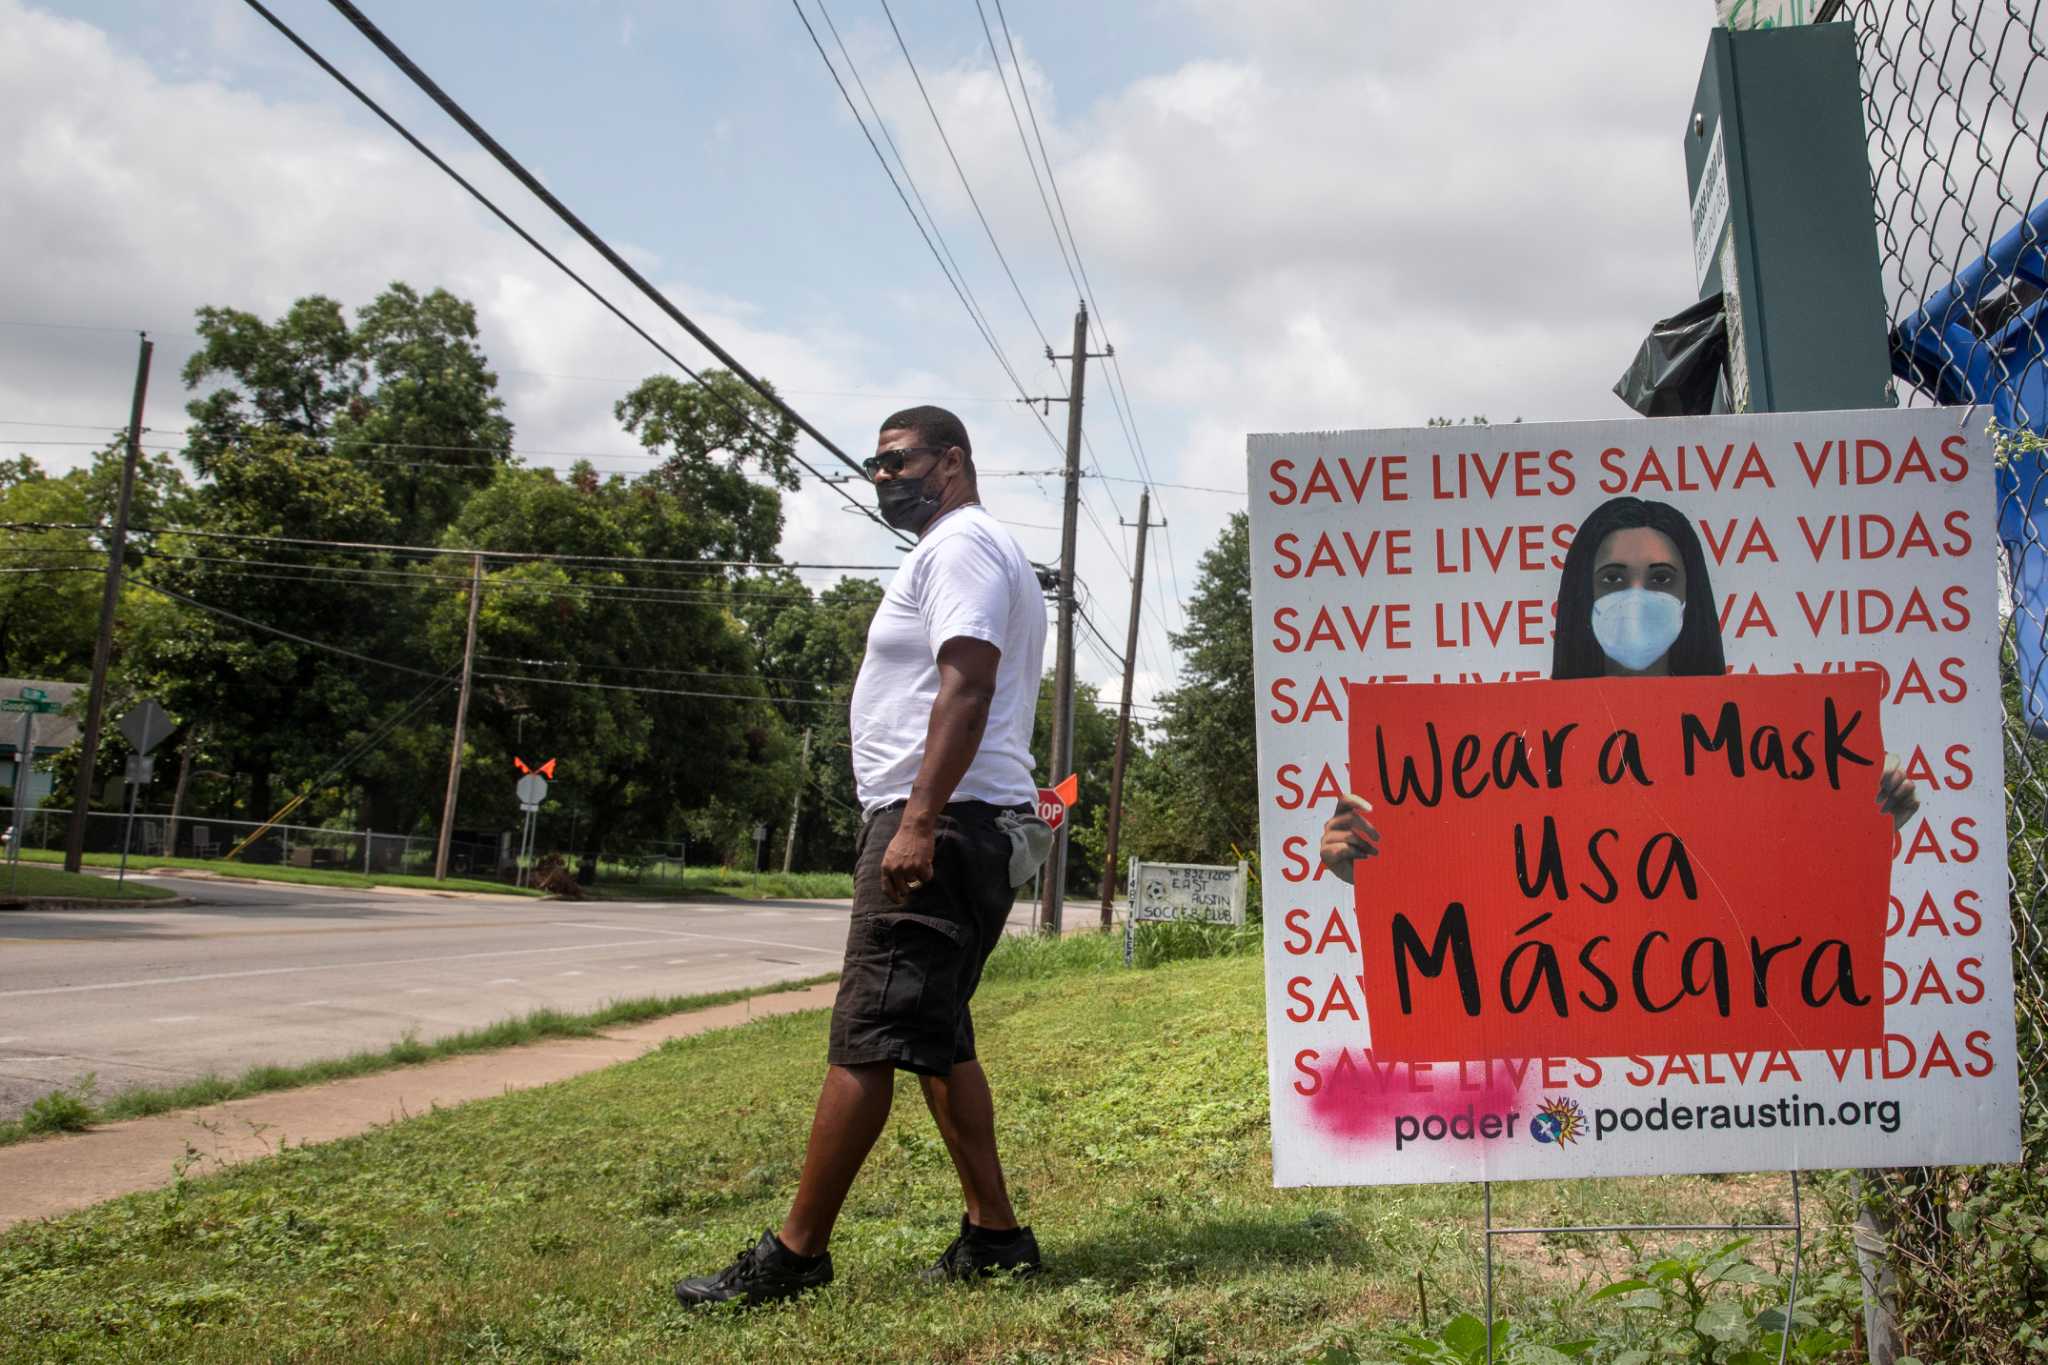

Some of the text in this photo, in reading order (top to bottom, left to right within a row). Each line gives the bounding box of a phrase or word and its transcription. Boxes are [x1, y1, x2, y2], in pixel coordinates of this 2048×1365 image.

[1270, 436, 1968, 504] SAVE LIVES SALVA VIDAS
[1274, 530, 1411, 579] SAVE
[1798, 511, 1972, 560] VIDAS
[1273, 604, 1411, 653] SAVE
[1436, 599, 1558, 648] LIVE
[1797, 586, 1970, 635] VIDAS
[1271, 675, 1408, 724] SA
[1376, 722, 1579, 808] Wear
[1598, 730, 1653, 786] a
[1681, 697, 1874, 790] Mask
[1275, 762, 1351, 810] SA
[1171, 878, 1209, 893] EAST
[1191, 893, 1231, 906] AUSTIN
[1284, 906, 1357, 956] SA
[1392, 901, 1872, 1018] Máscara
[1286, 957, 1986, 1024] SA DAS
[1293, 1030, 1994, 1096] SAVE LIVES SALVA VIDAS
[1395, 1105, 1521, 1151] poder
[1595, 1094, 1901, 1141] poderaustin.org
